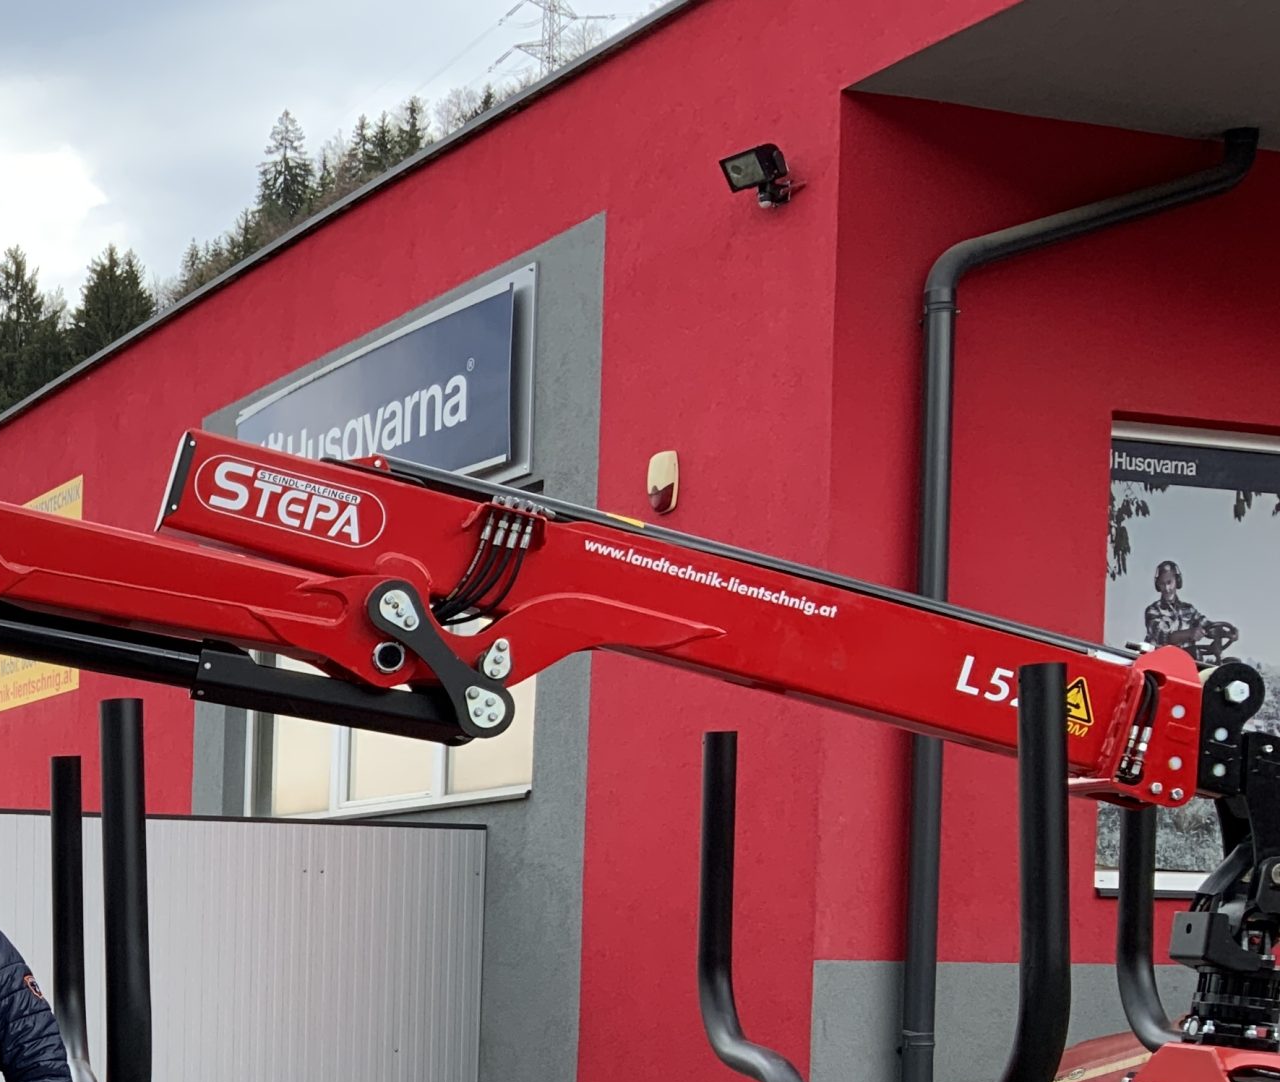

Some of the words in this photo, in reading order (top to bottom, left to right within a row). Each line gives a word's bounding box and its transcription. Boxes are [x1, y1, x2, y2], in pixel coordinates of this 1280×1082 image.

[259, 471, 359, 503] STEINDL-PALFINGER
[1114, 451, 1197, 476] Husqvarna
[209, 461, 360, 543] STEPA
[584, 539, 837, 618] www.landtechnik-lientschnig.at
